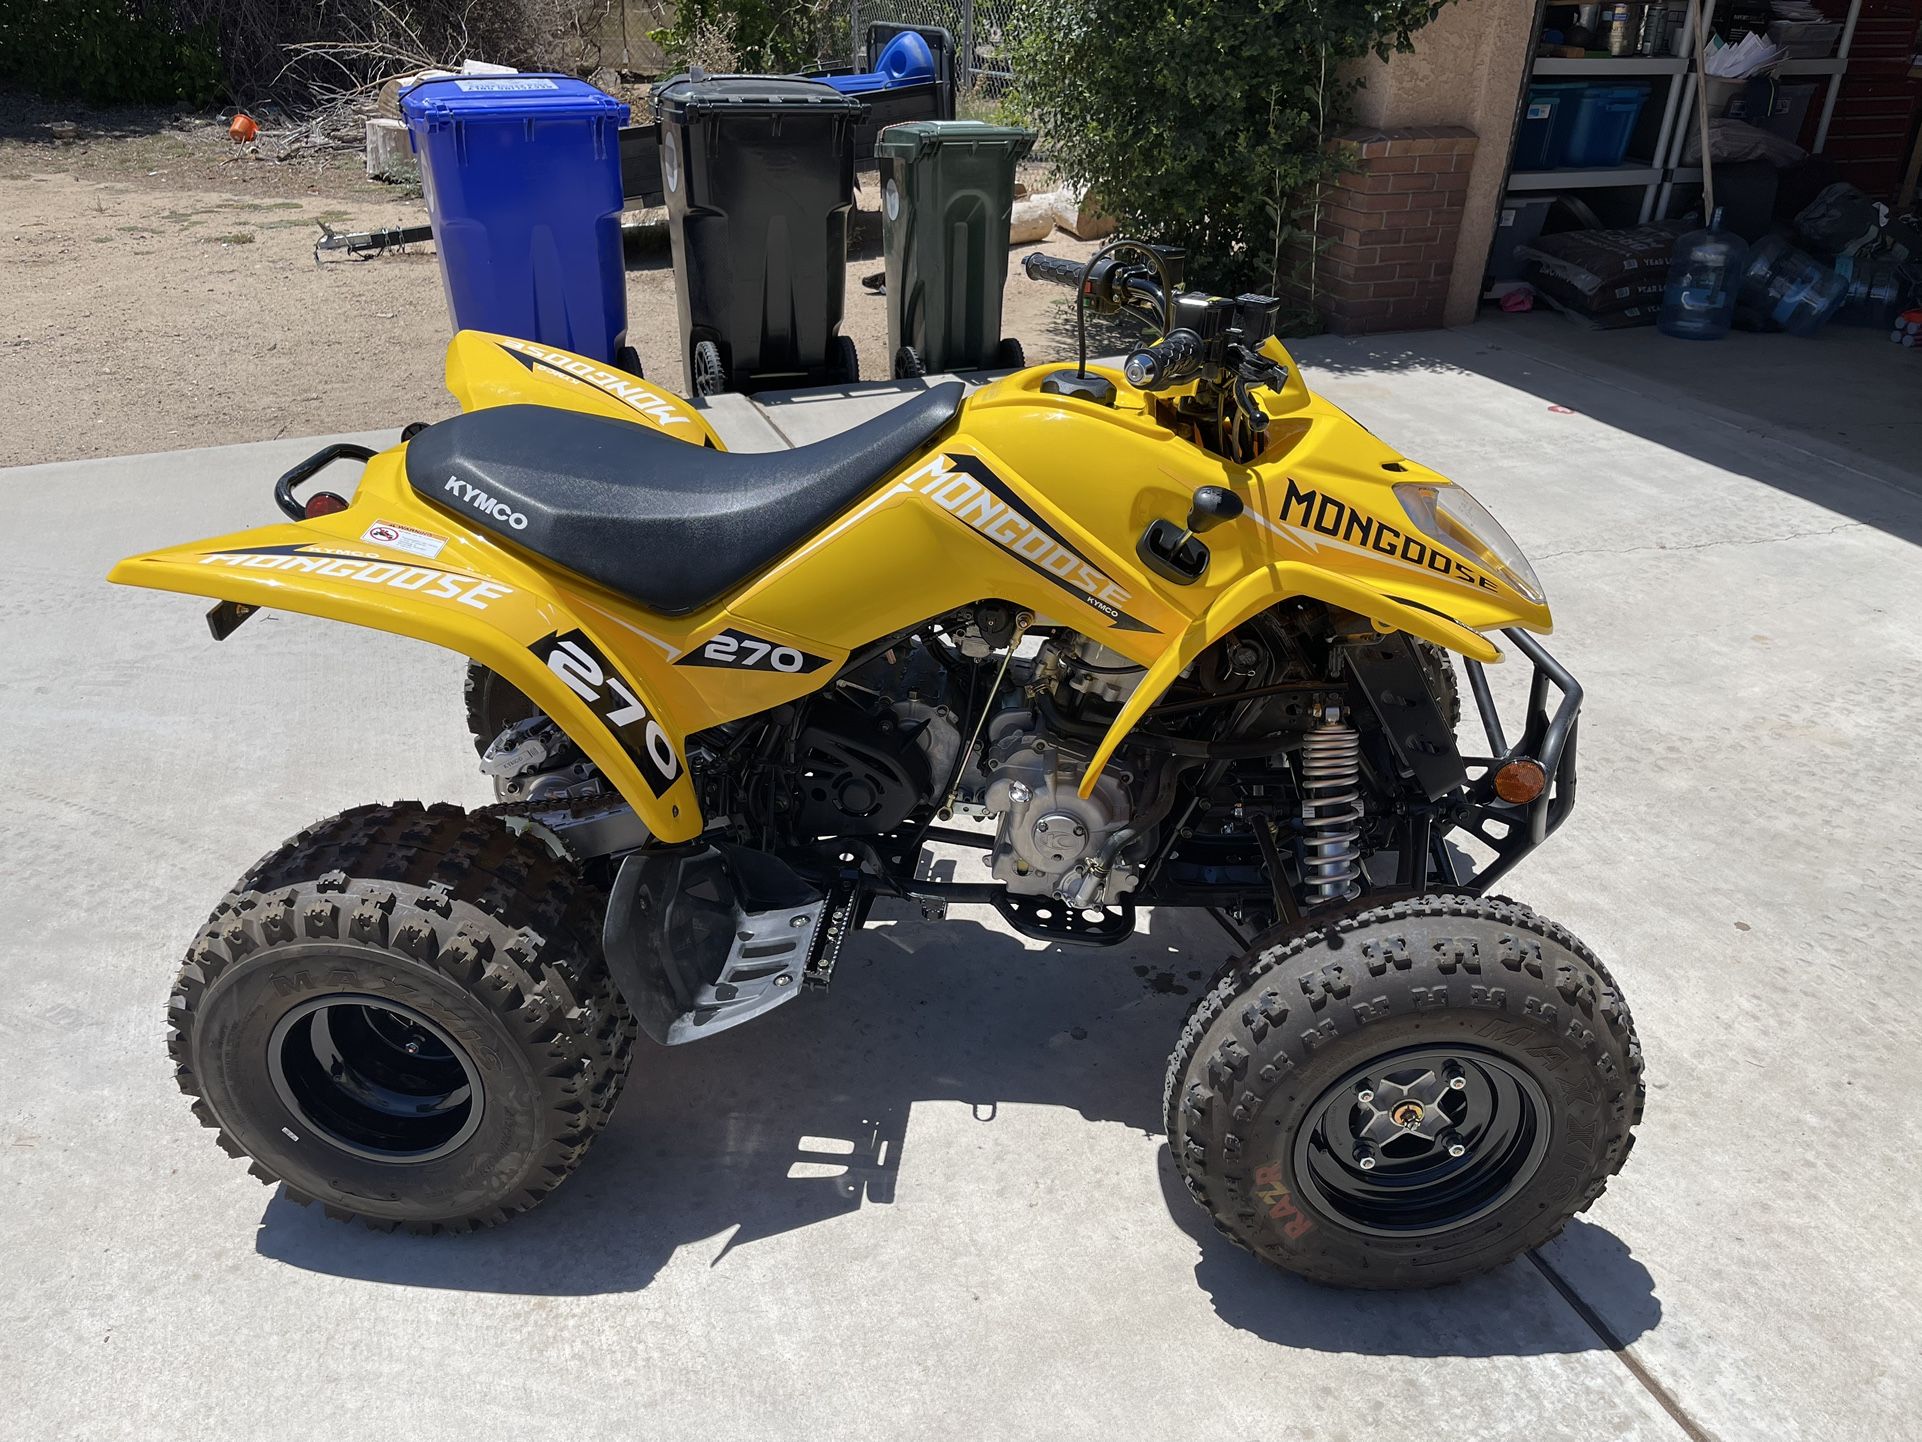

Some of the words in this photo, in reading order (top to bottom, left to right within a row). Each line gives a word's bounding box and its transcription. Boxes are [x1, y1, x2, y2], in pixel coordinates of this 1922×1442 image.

[501, 339, 691, 426] MONGOOSE
[444, 475, 529, 530] KYMCO
[904, 453, 1133, 610] MONGOOSE
[1279, 477, 1499, 593] MONGOOSE
[199, 553, 514, 610] MONGOOSE
[307, 546, 381, 559] KYMCO
[1087, 596, 1119, 618] KYMCO
[704, 634, 804, 673] 270
[547, 640, 677, 780] 270
[1474, 1017, 1598, 1202] MAXXIS
